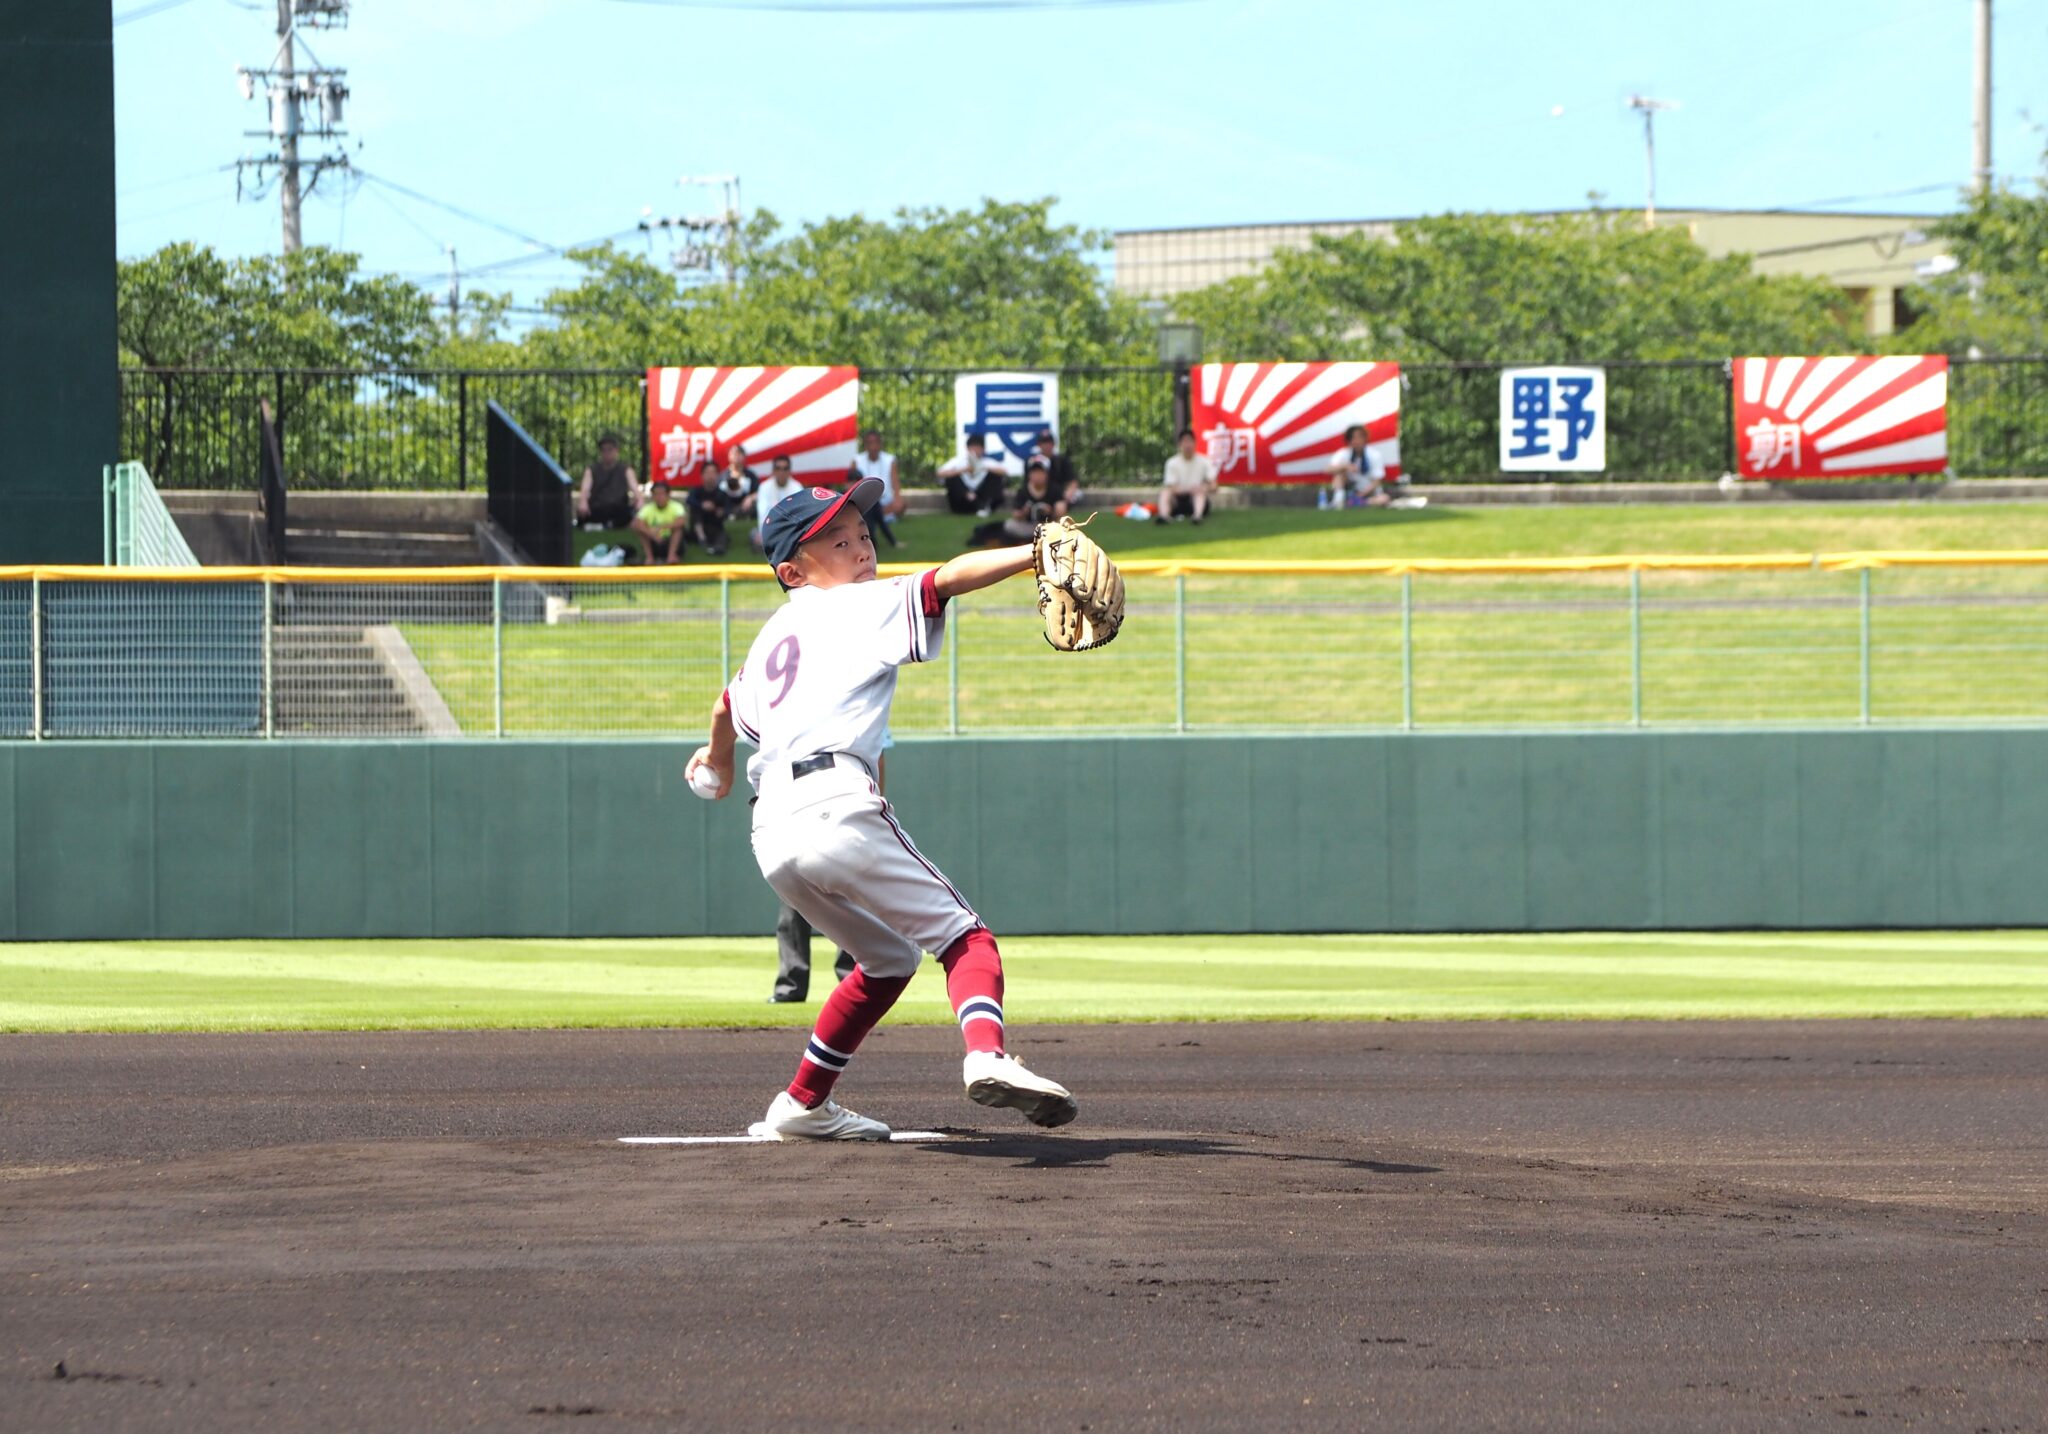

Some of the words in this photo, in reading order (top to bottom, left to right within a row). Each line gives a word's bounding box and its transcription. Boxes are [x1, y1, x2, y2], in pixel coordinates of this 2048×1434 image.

[659, 424, 714, 480] 朝
[964, 382, 1050, 462] 長
[1201, 421, 1257, 475] 朝
[1509, 377, 1596, 462] 野
[1745, 416, 1801, 472] 朝
[765, 633, 801, 710] 9
